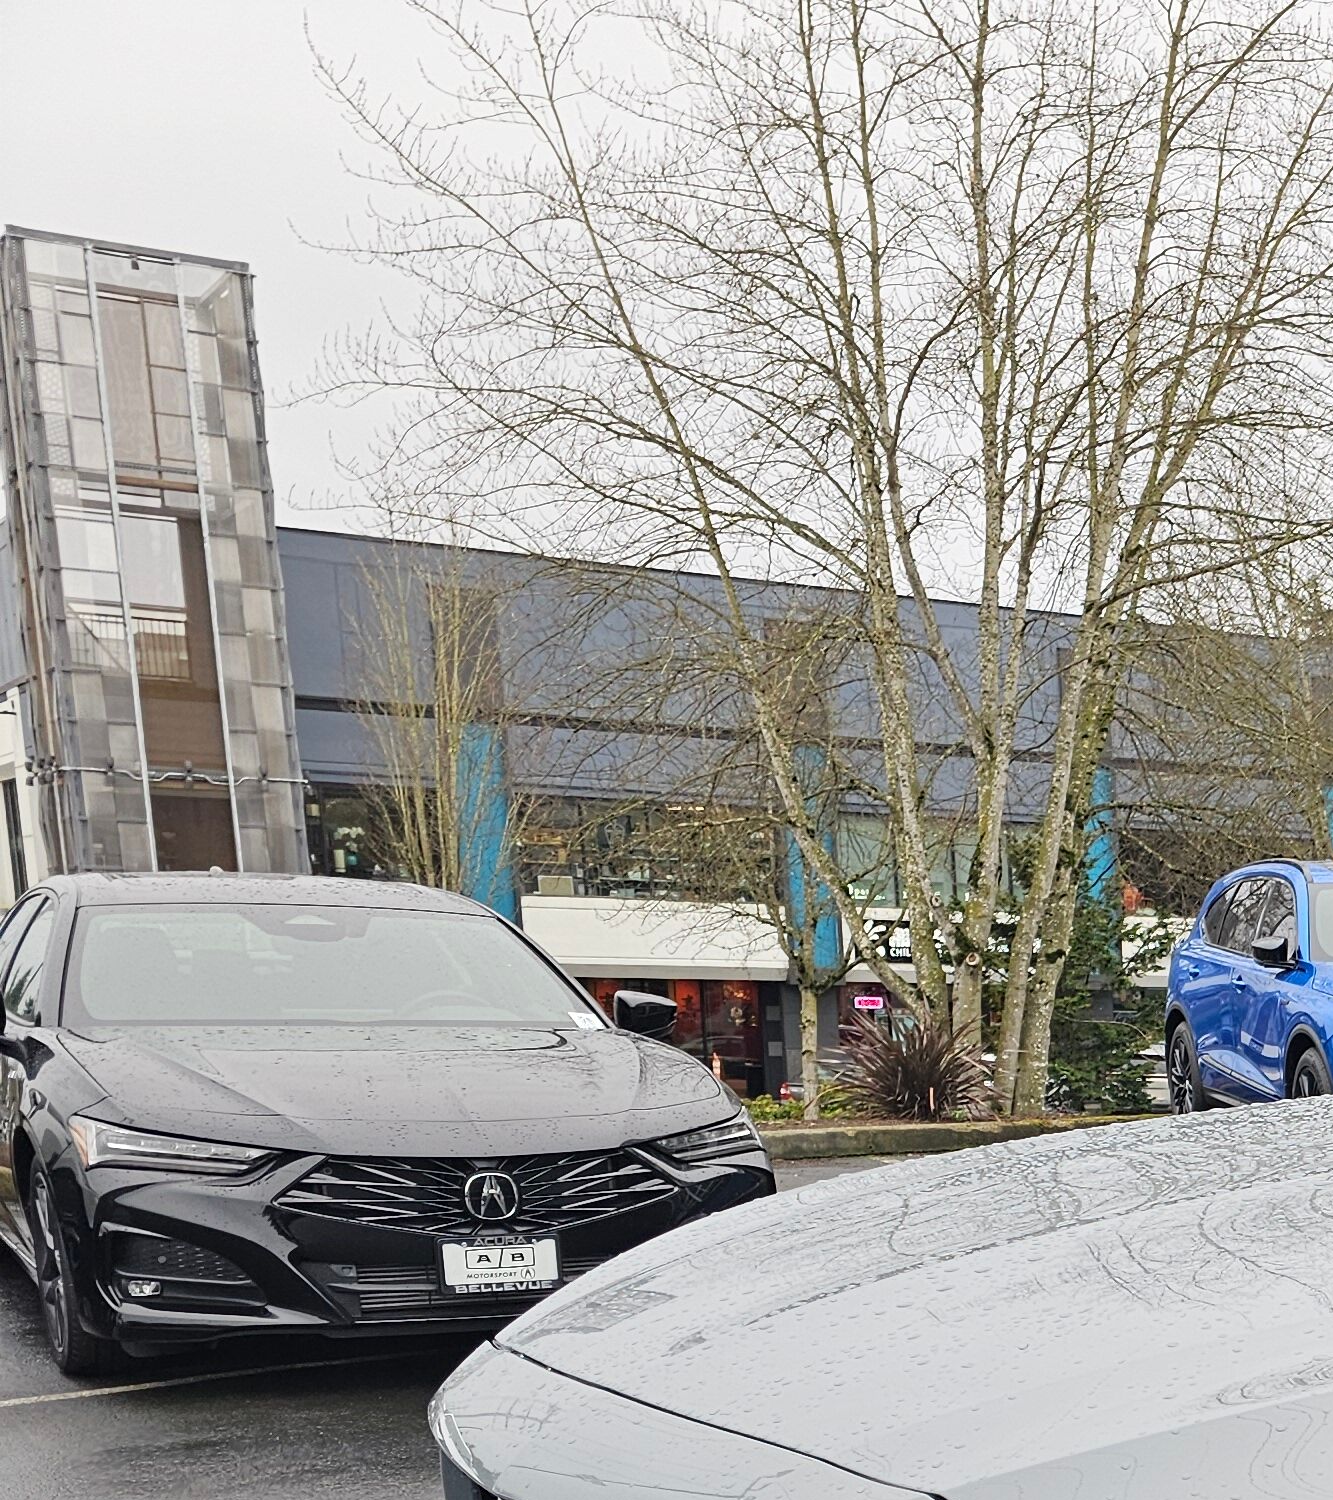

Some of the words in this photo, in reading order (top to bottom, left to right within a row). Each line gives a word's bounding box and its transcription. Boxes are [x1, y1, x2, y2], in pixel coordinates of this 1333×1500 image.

[473, 1235, 528, 1247] ACURA
[466, 1271, 518, 1280] MOTORSPORT
[455, 1280, 553, 1294] BELLEVUE
